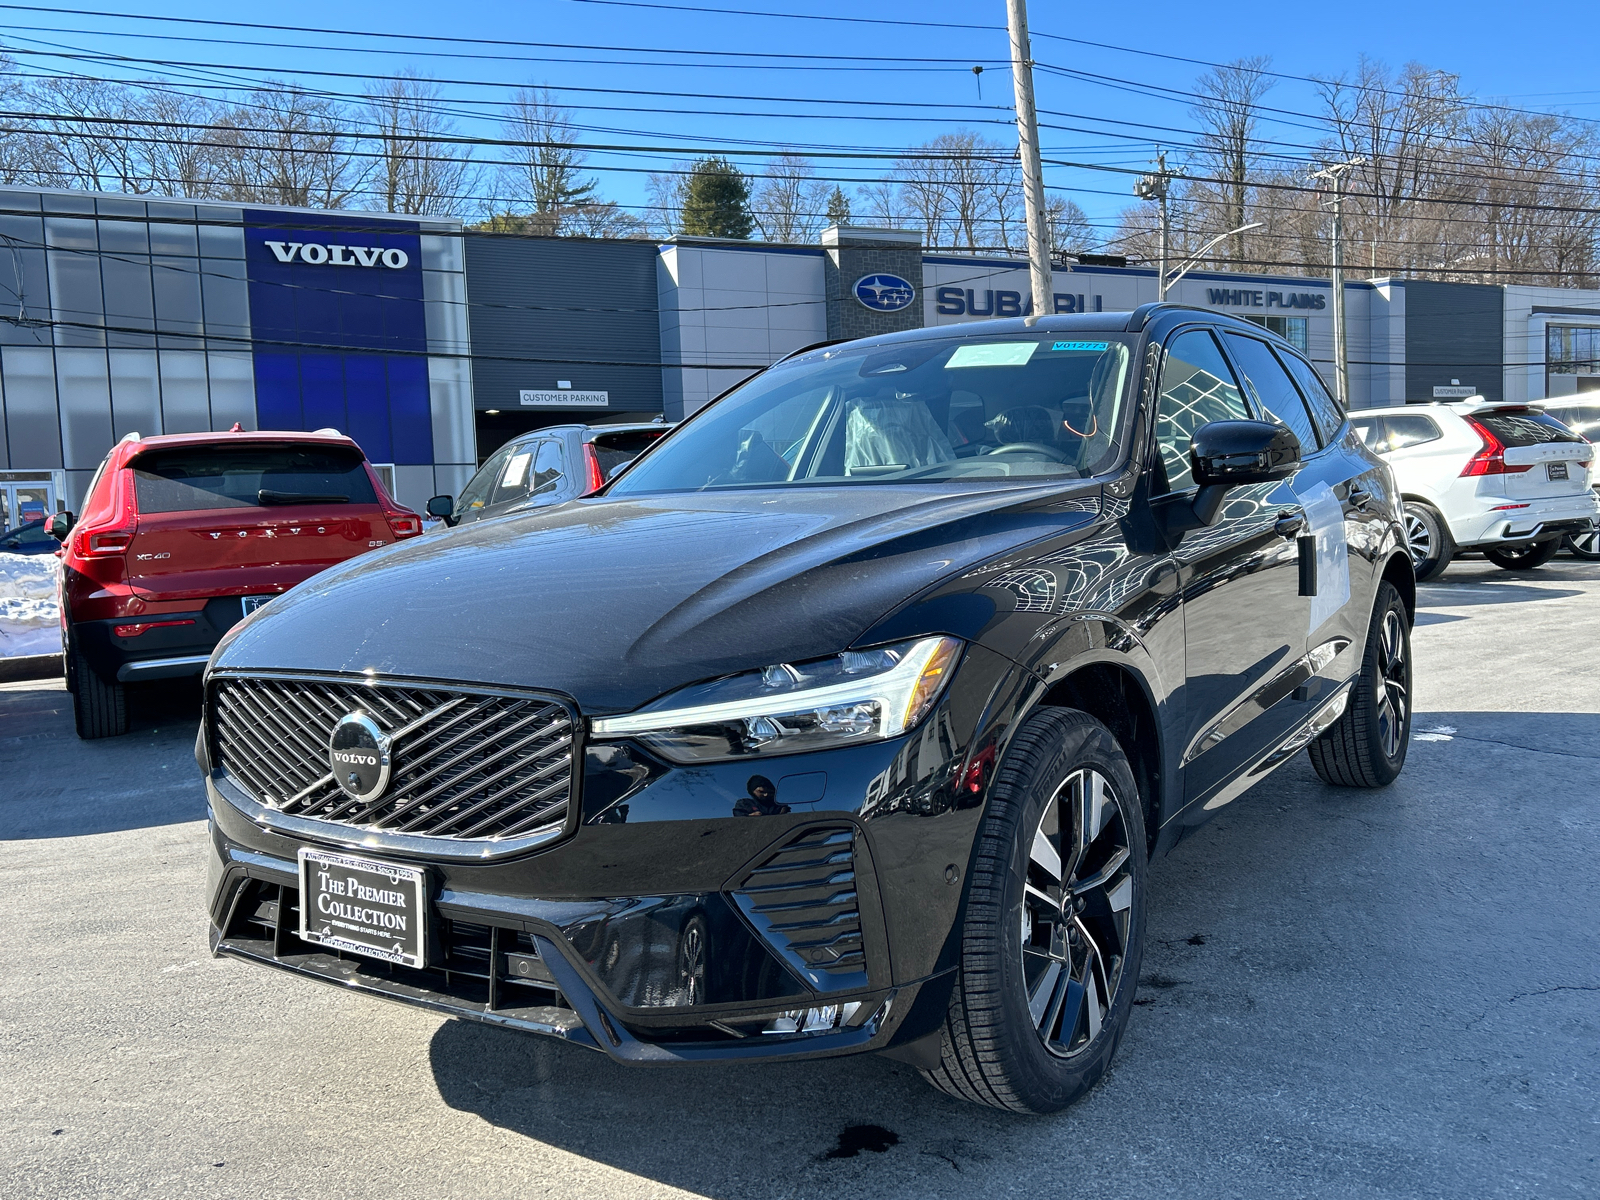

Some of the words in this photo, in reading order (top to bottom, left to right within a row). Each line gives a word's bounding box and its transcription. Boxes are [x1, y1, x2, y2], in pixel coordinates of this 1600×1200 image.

[264, 240, 409, 269] VOLVO
[937, 286, 1103, 317] SUBRU
[1207, 288, 1264, 307] WHITE
[1266, 291, 1326, 310] PLAINS
[1055, 342, 1107, 350] V012773
[523, 393, 568, 402] CUSTOMER
[570, 394, 606, 403] PARKING
[333, 752, 377, 766] VOLVO
[317, 871, 346, 896] THE
[346, 877, 407, 908] PREMIER
[317, 892, 407, 931] COLLECTION
